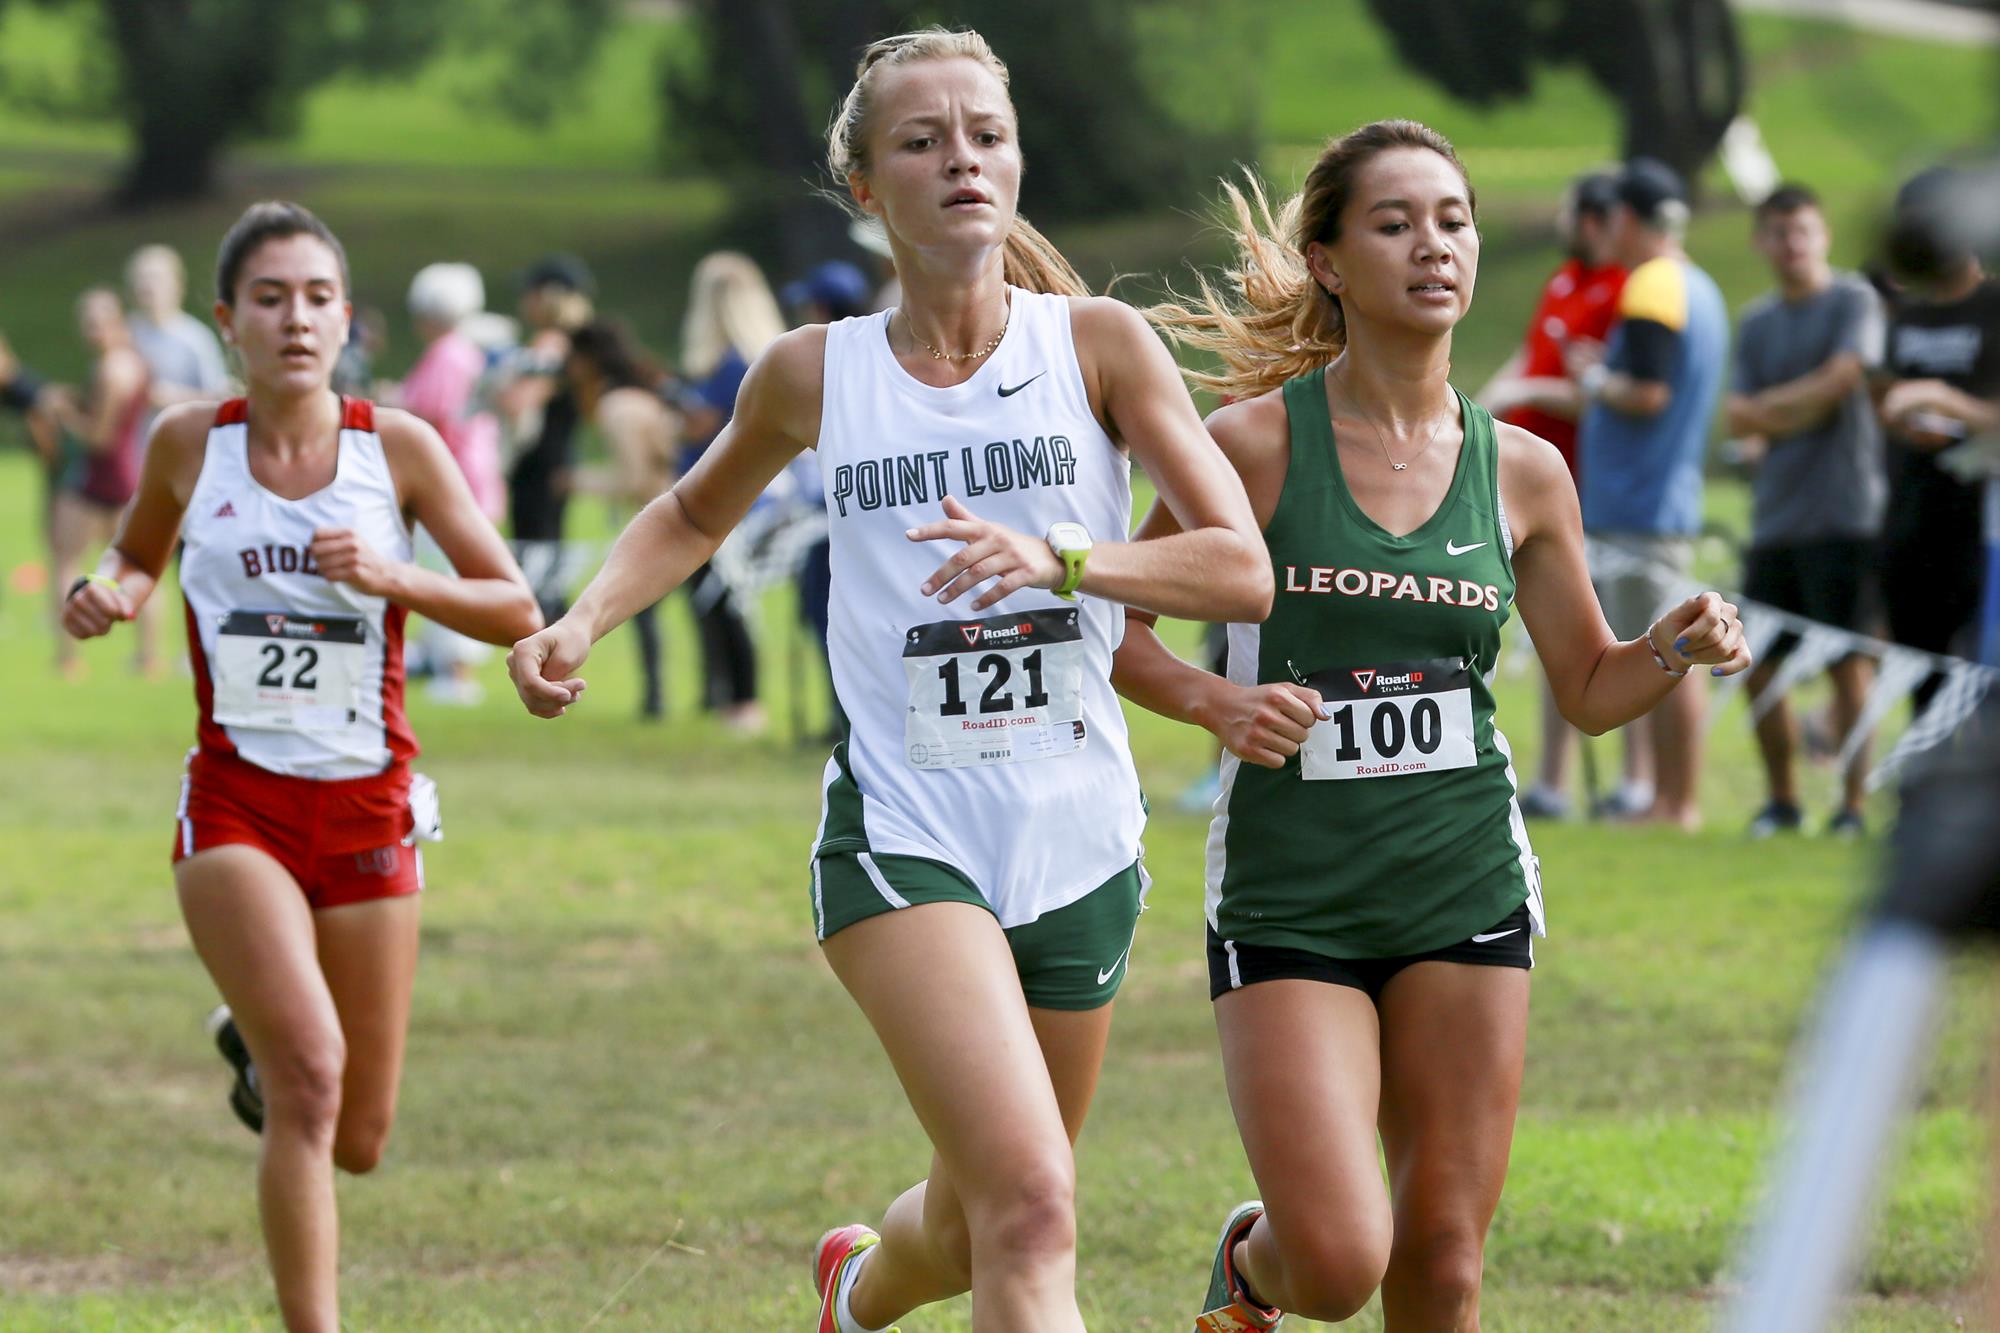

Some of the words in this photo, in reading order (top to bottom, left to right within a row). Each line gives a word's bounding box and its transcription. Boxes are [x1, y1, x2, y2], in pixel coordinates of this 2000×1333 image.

[833, 450, 949, 517] POINT
[961, 435, 1077, 498] LOMA
[239, 543, 326, 578] BIOL
[1285, 565, 1499, 612] LEOPARDS
[982, 623, 1033, 640] RoadID
[258, 643, 319, 690] 22
[938, 648, 1049, 716] 121
[1376, 671, 1424, 686] RoadID
[962, 715, 1036, 731] RoadID.com
[1333, 697, 1443, 762] 100
[1356, 761, 1427, 776] RoadID.com
